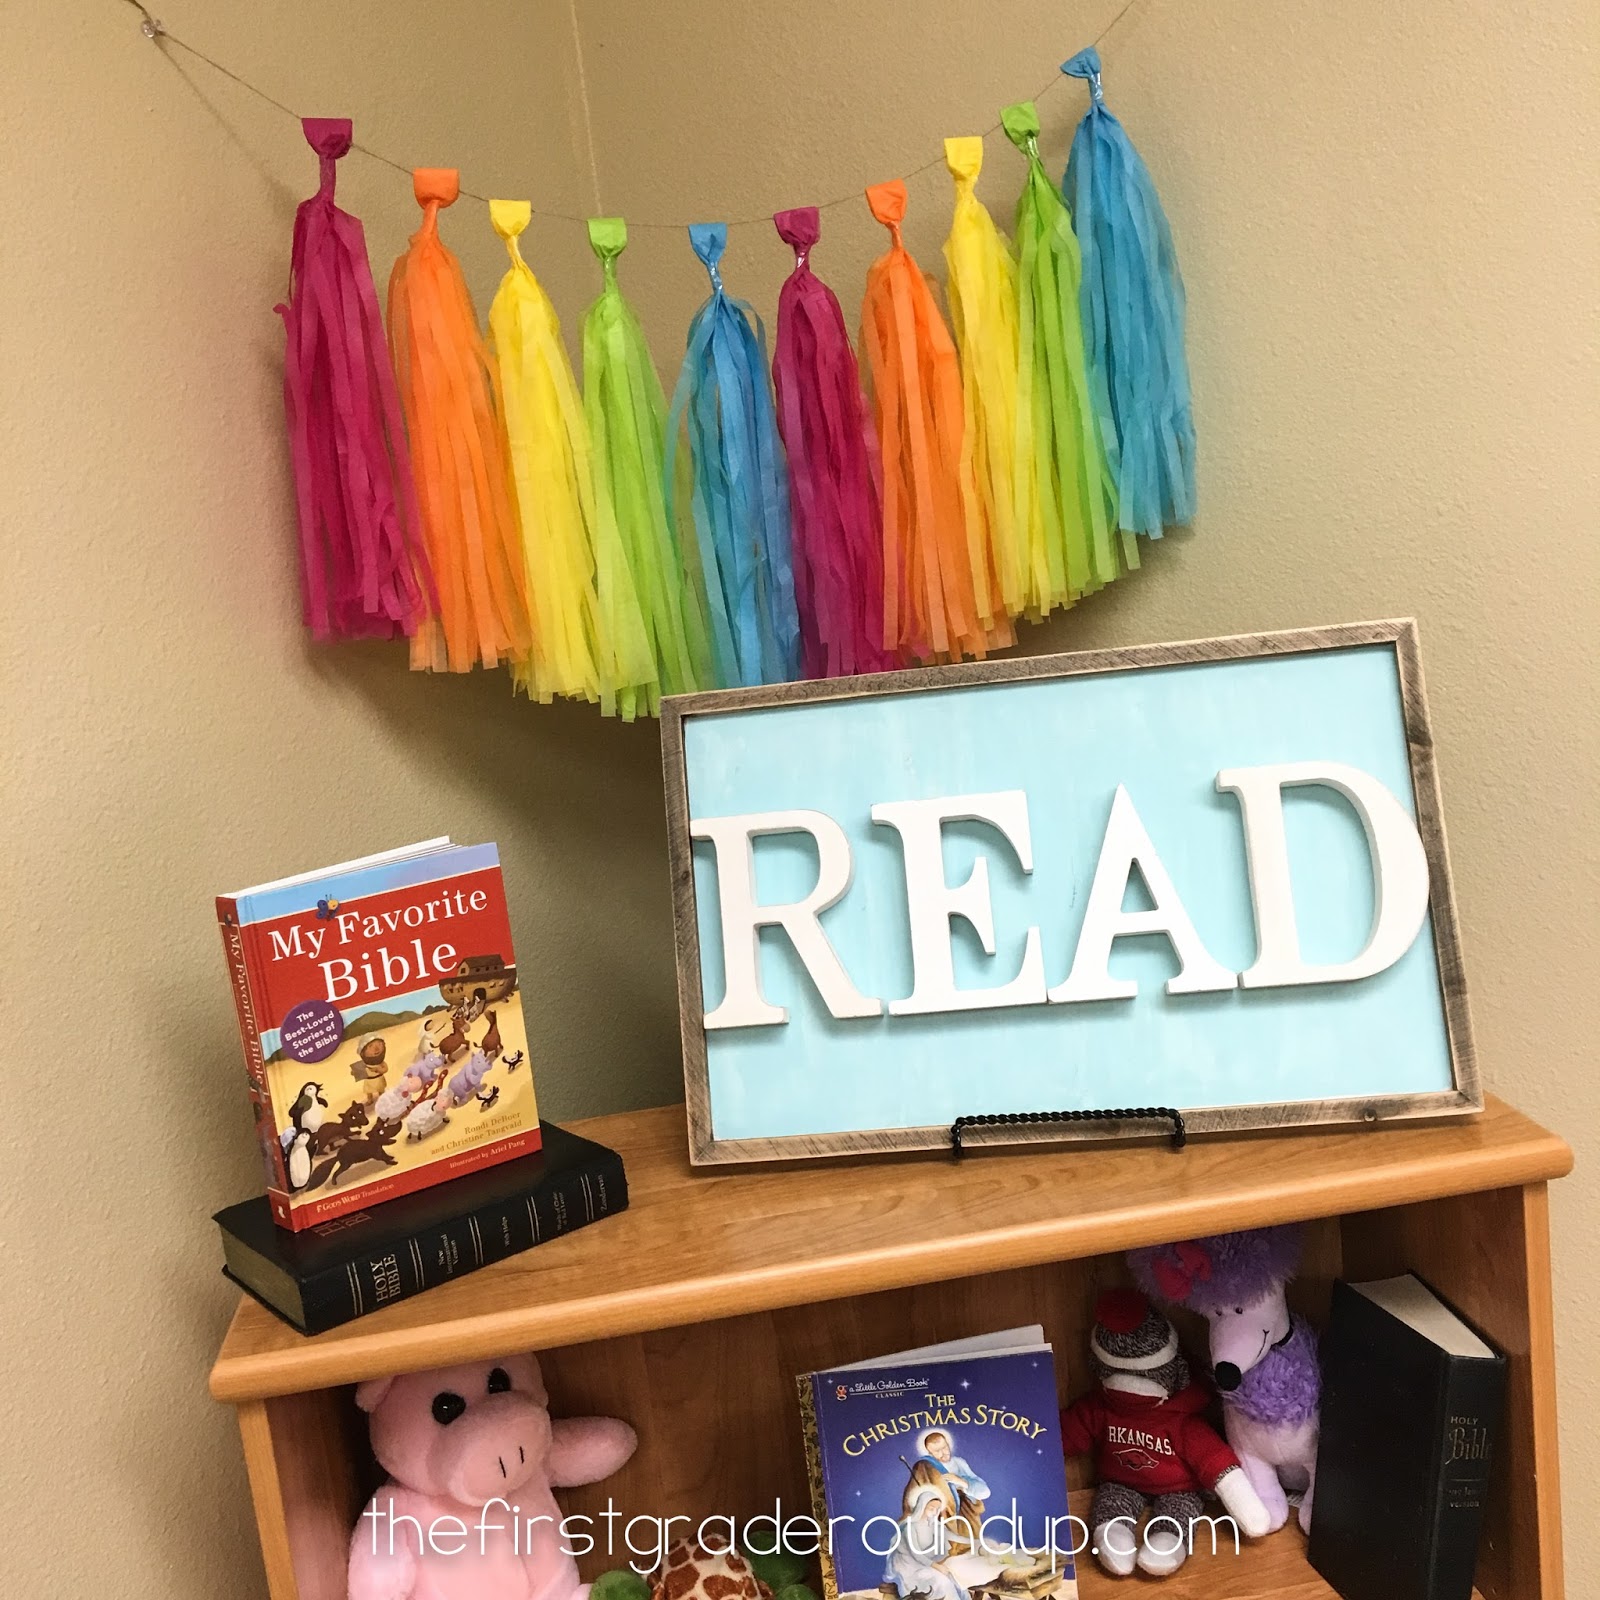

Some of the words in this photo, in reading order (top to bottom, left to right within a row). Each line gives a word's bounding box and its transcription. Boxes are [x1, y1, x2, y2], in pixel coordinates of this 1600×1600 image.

[691, 761, 1429, 1030] READ
[268, 925, 325, 961] My
[335, 889, 487, 945] Favorite
[318, 938, 457, 1003] Bible
[229, 932, 241, 959] My
[236, 963, 255, 1036] Favorite
[250, 1040, 265, 1085] Bible
[296, 1011, 314, 1022] The
[284, 1010, 335, 1041] Best-Loved
[292, 1030, 325, 1049] Stories
[325, 1021, 335, 1032] of
[297, 1047, 314, 1058] the
[314, 1034, 338, 1049] Bible
[431, 1145, 445, 1155] and
[446, 1132, 484, 1150] Christine
[481, 1151, 489, 1159] by
[490, 1142, 507, 1155] Ariel
[508, 1139, 525, 1150] Pang
[438, 1249, 446, 1267] New
[370, 1261, 389, 1302] HOLY
[383, 1253, 401, 1298] BIBLE
[855, 1382, 877, 1393] Little
[877, 1380, 906, 1391] Golden
[906, 1377, 929, 1388] Book
[875, 1391, 905, 1399] CLASSIC
[842, 1407, 971, 1457] CHRISTMAS
[974, 1404, 1047, 1440] STORY
[1450, 1416, 1479, 1425] HOLY
[1108, 1425, 1172, 1456] RKANSAS
